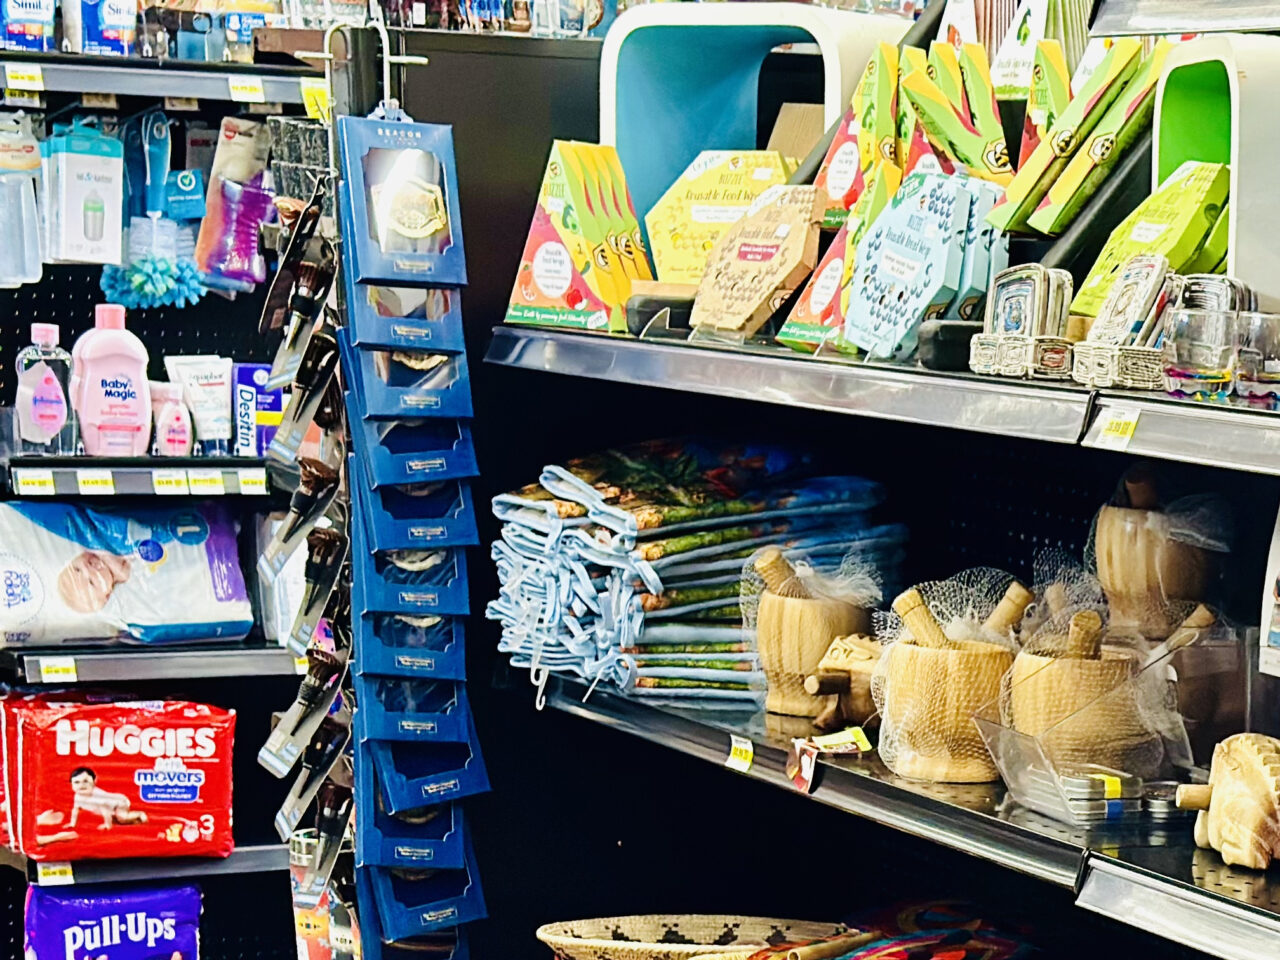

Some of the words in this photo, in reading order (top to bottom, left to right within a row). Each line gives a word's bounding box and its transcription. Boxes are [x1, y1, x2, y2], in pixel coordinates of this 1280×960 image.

[101, 378, 130, 391] Baby
[104, 388, 138, 402] Magic
[239, 388, 256, 449] Desitin
[55, 719, 217, 758] HUGGIES
[137, 770, 203, 784] movers
[199, 814, 216, 836] 3
